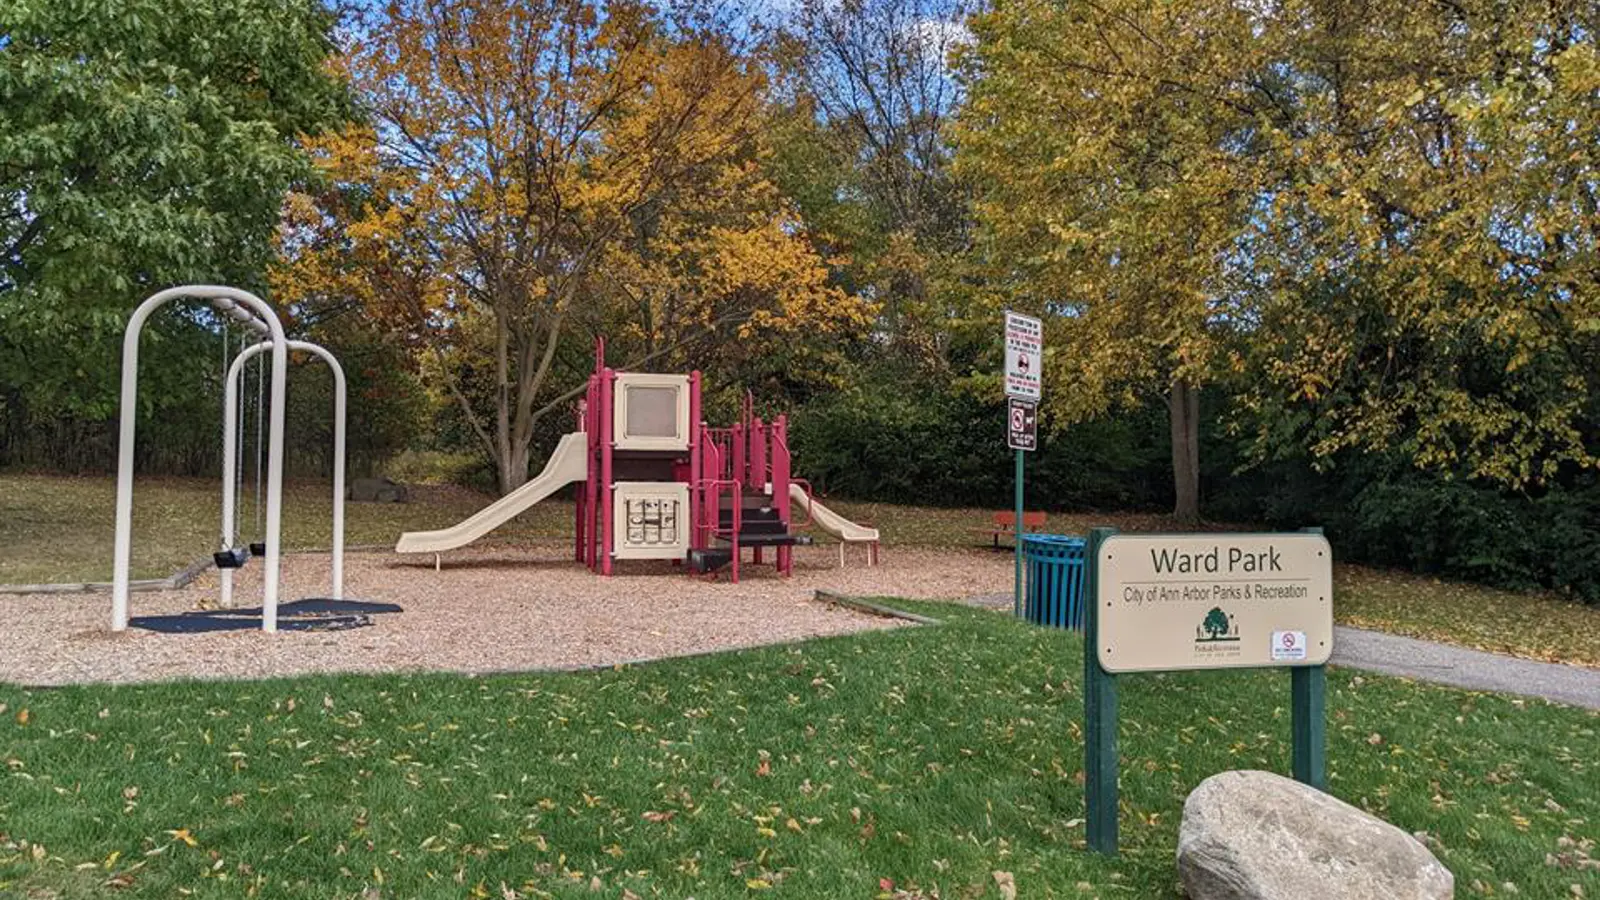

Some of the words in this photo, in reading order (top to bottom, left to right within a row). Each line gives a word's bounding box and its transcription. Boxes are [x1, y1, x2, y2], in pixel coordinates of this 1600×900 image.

[1151, 546, 1218, 573] Ward
[1229, 545, 1282, 572] Park
[1123, 586, 1143, 605] City
[1146, 586, 1158, 602] of
[1160, 587, 1179, 601] Ann
[1182, 586, 1210, 601] Arbor
[1213, 585, 1242, 600] Parks
[1244, 584, 1252, 600] &
[1255, 584, 1307, 599] Recreation
